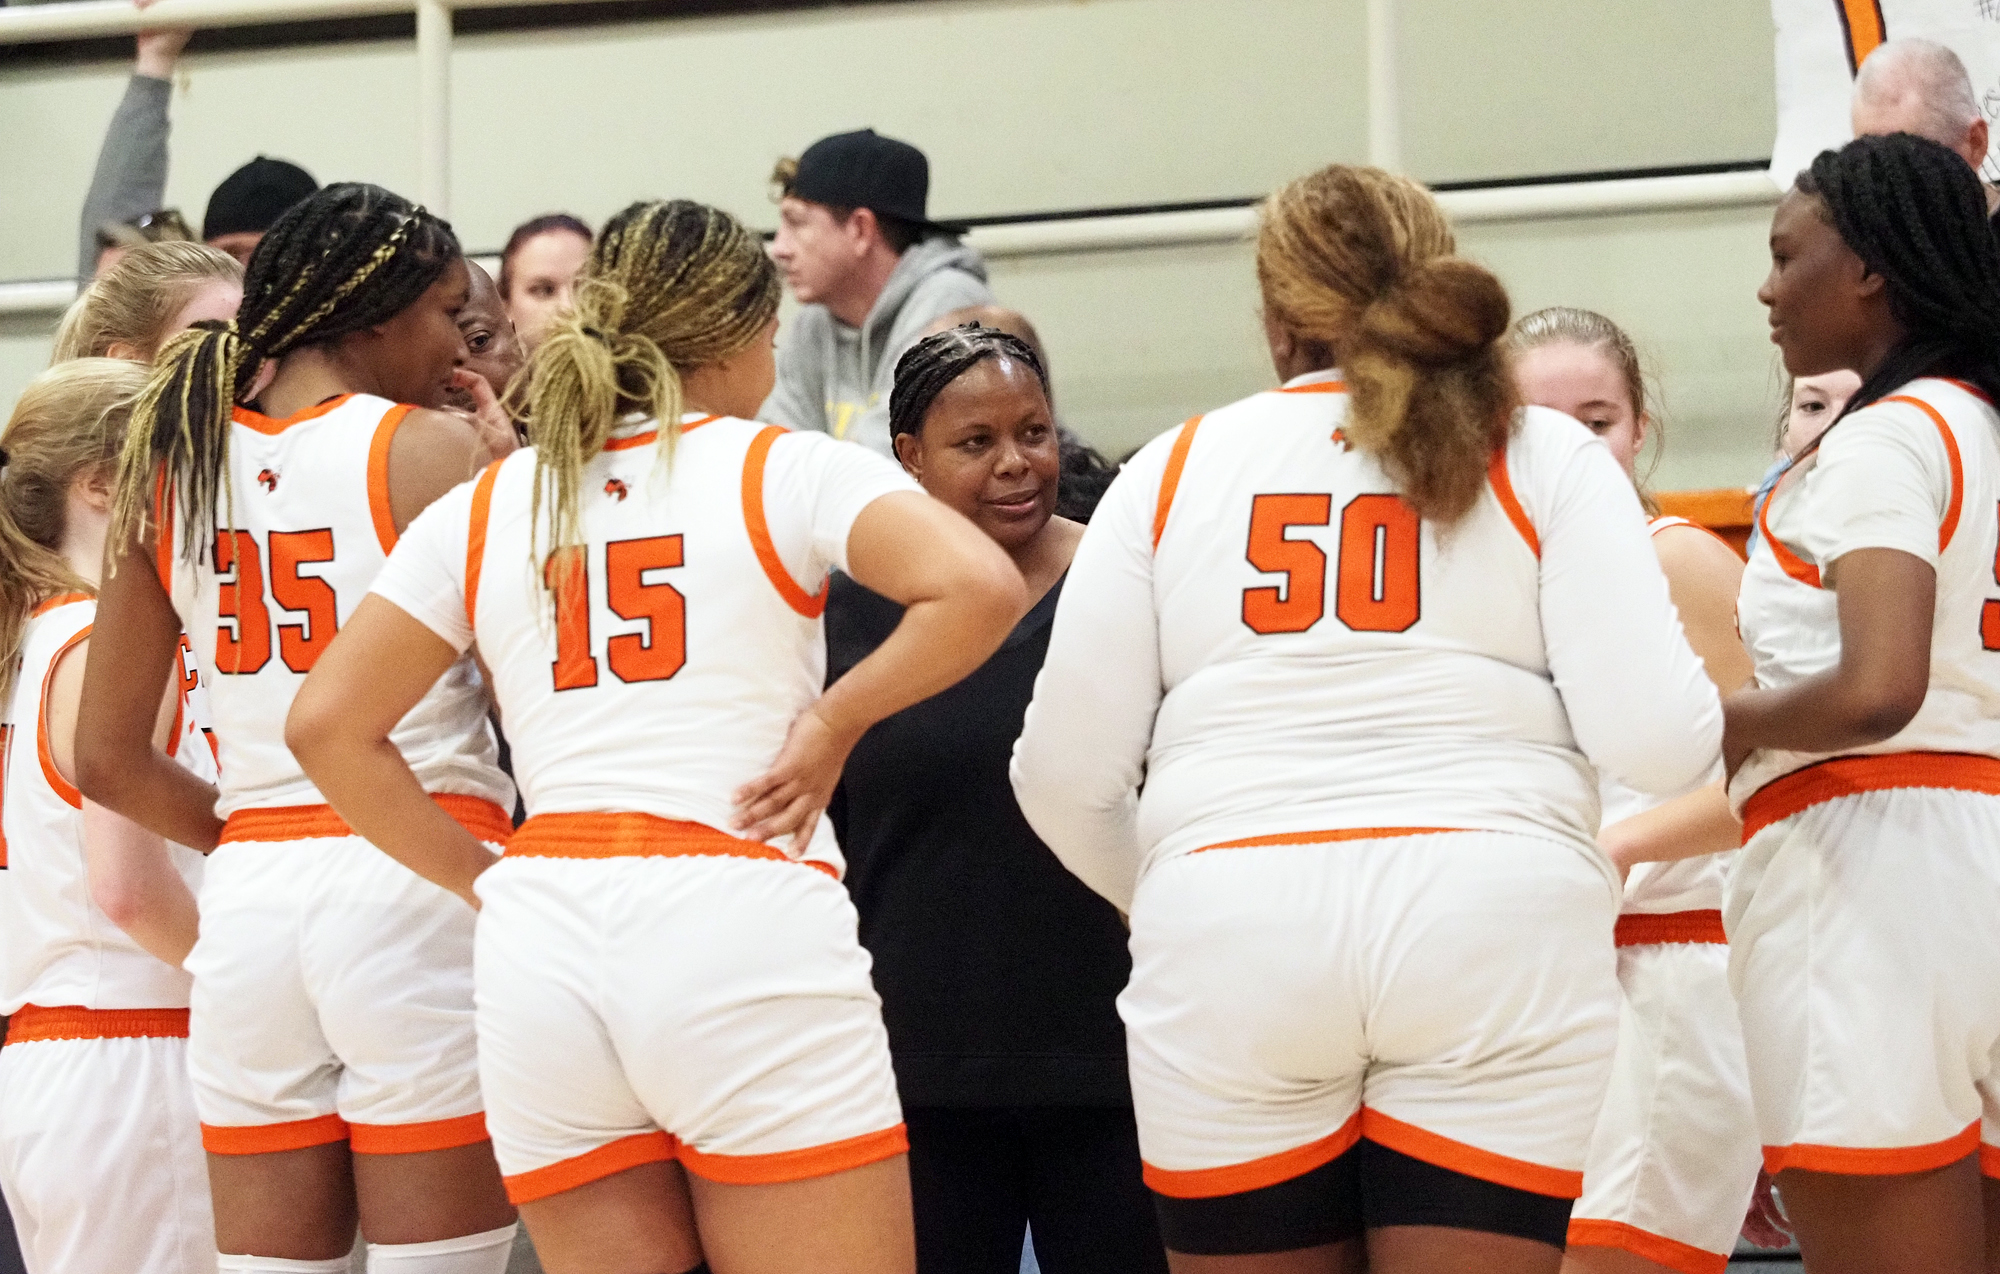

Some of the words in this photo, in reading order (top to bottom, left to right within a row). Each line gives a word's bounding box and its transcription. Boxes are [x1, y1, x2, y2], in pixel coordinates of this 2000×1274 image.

[212, 527, 339, 675] 35
[543, 533, 687, 692] 15
[1241, 493, 1421, 635] 50
